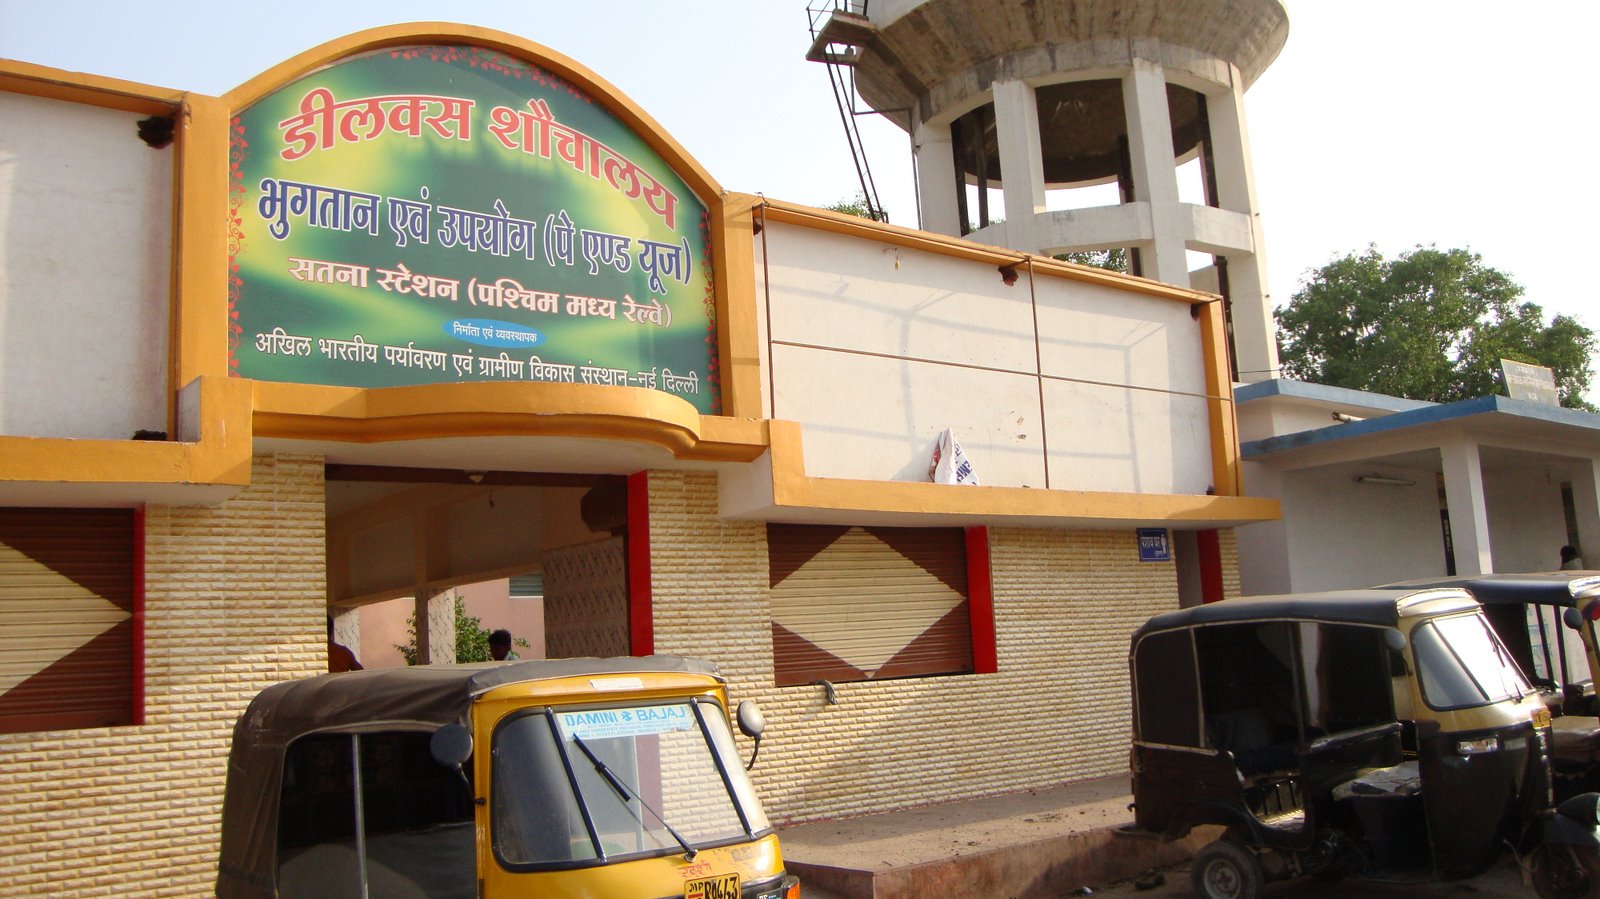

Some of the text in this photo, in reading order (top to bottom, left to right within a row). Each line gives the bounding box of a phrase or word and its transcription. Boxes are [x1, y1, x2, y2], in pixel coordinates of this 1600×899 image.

[279, 87, 679, 232] डीलक्स शौचालय
[259, 178, 381, 240] भुगतान
[387, 186, 431, 247] एवं
[437, 199, 536, 260] उपयोग
[581, 229, 631, 275] एण्ड
[638, 237, 692, 295] यूज)
[288, 256, 370, 288] सतना
[376, 263, 460, 301] स्टेशन
[467, 277, 560, 314] (पश्चिम
[564, 294, 617, 320] मध्य
[255, 326, 312, 357] अखिल
[318, 334, 378, 364] भारतीय
[384, 341, 447, 371] पर्यावरण
[452, 348, 474, 377] एवं
[479, 352, 524, 380] ग्रामीण
[529, 355, 575, 383] विकास
[661, 367, 699, 395] दिल्ली
[453, 321, 537, 342] निर्माता एवं व्यवस्थापक
[564, 711, 618, 727] DAMINI
[636, 706, 687, 721] BAJAJ
